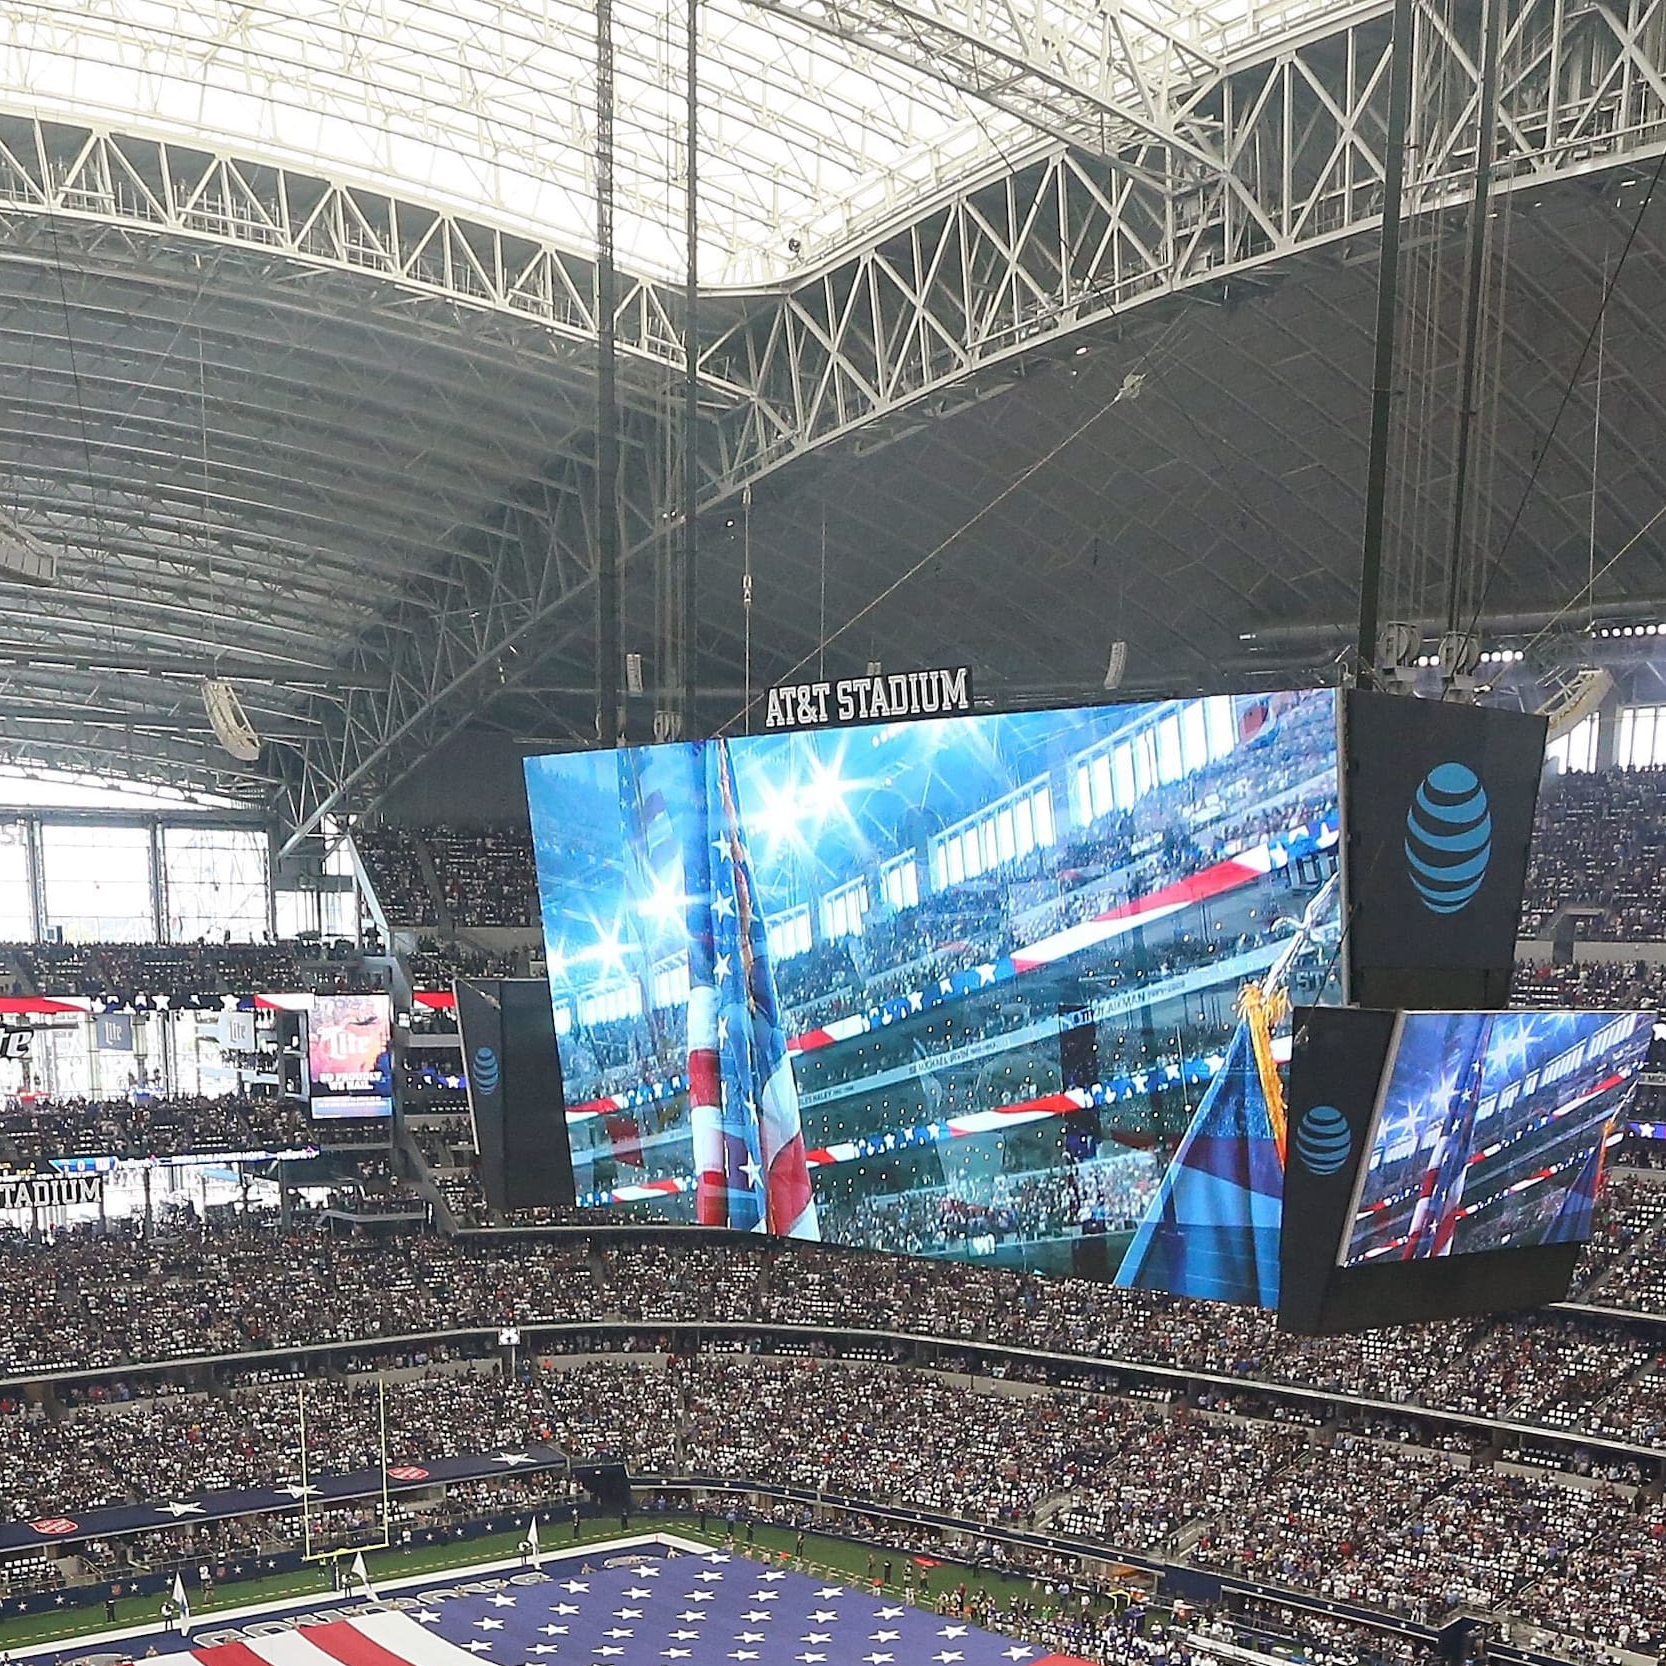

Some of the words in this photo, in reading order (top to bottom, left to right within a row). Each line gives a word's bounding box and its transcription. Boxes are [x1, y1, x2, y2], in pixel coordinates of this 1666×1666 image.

[765, 682, 830, 727] AT&T
[836, 667, 969, 720] STADIUM
[104, 1020, 123, 1046] Lite
